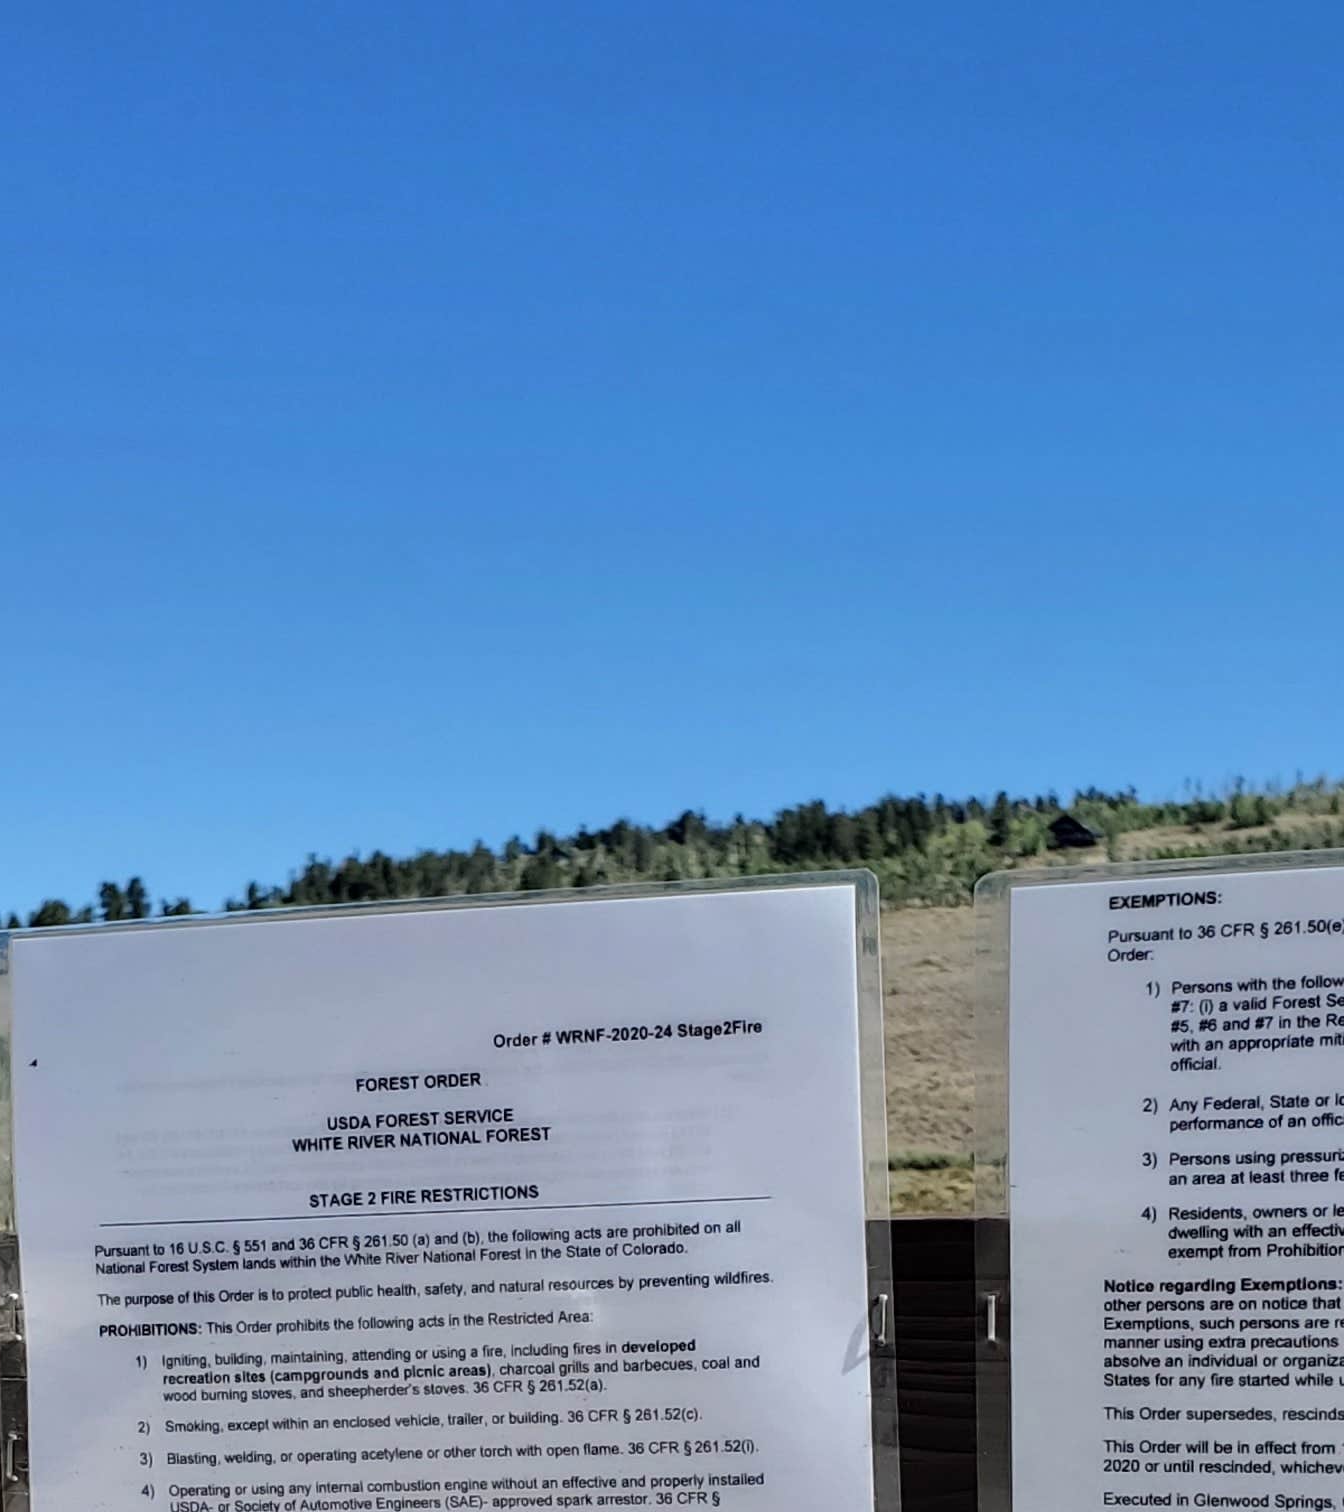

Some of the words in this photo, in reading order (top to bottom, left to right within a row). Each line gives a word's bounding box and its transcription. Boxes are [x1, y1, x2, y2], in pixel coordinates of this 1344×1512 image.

[1108, 890, 1221, 910] EXEMPTIONS:
[1108, 927, 1174, 943] Pursuant
[1178, 927, 1192, 940] to
[1197, 924, 1216, 939] 36
[1220, 922, 1254, 938] CFR
[493, 1033, 538, 1048] Order
[542, 1031, 551, 1045] #
[555, 1023, 672, 1044] WRNF-2020-24
[677, 1019, 762, 1040] Stage2Fire
[1170, 1056, 1221, 1071] official.
[355, 1075, 419, 1092] FOREST
[423, 1072, 481, 1089] ORDER
[327, 1114, 371, 1131] USDA
[375, 1111, 439, 1128] FOREST
[443, 1107, 514, 1125] SERVICE
[291, 1136, 344, 1152] WHITE
[347, 1133, 396, 1150] RIVER
[399, 1130, 481, 1147] NATIONAL
[485, 1126, 551, 1143] FOREST
[309, 1191, 363, 1208] STAGE
[367, 1191, 376, 1205] 2
[380, 1189, 416, 1205] FIRE
[420, 1184, 539, 1203] RESTRICTIONS
[1167, 1244, 1224, 1261] exempt
[1227, 1243, 1261, 1257] from
[97, 1293, 120, 1306] The
[124, 1293, 174, 1308] purpose
[177, 1290, 190, 1304] of
[192, 1290, 215, 1303] this
[218, 1289, 254, 1302] Order
[258, 1287, 268, 1301] is
[271, 1288, 284, 1301] to
[287, 1286, 332, 1303] protect
[335, 1284, 373, 1302] public
[376, 1283, 420, 1297] health,
[424, 1282, 466, 1297] safety,
[471, 1279, 495, 1294] and
[498, 1278, 544, 1293] natural
[548, 1278, 614, 1291] resources
[618, 1275, 634, 1292] by
[638, 1273, 710, 1290] preventing
[713, 1270, 773, 1285] wildfires.
[99, 1322, 202, 1337] PROHIBITIONS:
[205, 1321, 233, 1334] This
[235, 1320, 272, 1333] Order
[275, 1318, 330, 1335] prohibits
[333, 1317, 354, 1330] the
[357, 1316, 414, 1331] following
[418, 1315, 445, 1328] acts
[448, 1313, 459, 1326] in
[463, 1313, 484, 1326] the
[487, 1311, 553, 1325] Restricted
[557, 1310, 592, 1324] Area:
[137, 1420, 150, 1436] 2)
[165, 1419, 224, 1435] Smoking,
[227, 1418, 269, 1432] except
[271, 1417, 309, 1430] within
[312, 1419, 329, 1429] an
[332, 1415, 390, 1428] enclosed
[394, 1413, 444, 1427] vehicle,
[447, 1412, 487, 1427] trailer,
[491, 1414, 505, 1424] or
[508, 1410, 563, 1426] building.
[567, 1409, 584, 1423] 36
[587, 1408, 618, 1422] CFR
[634, 1407, 702, 1423] 261.52(c).
[1103, 1406, 1135, 1420] This
[1139, 1406, 1181, 1420] Order
[1185, 1407, 1276, 1423] supersedes,
[1103, 1491, 1172, 1506] Executed
[1176, 1492, 1189, 1506] in
[1193, 1492, 1269, 1508] Glenwood
[1274, 1493, 1336, 1512] Springs,
